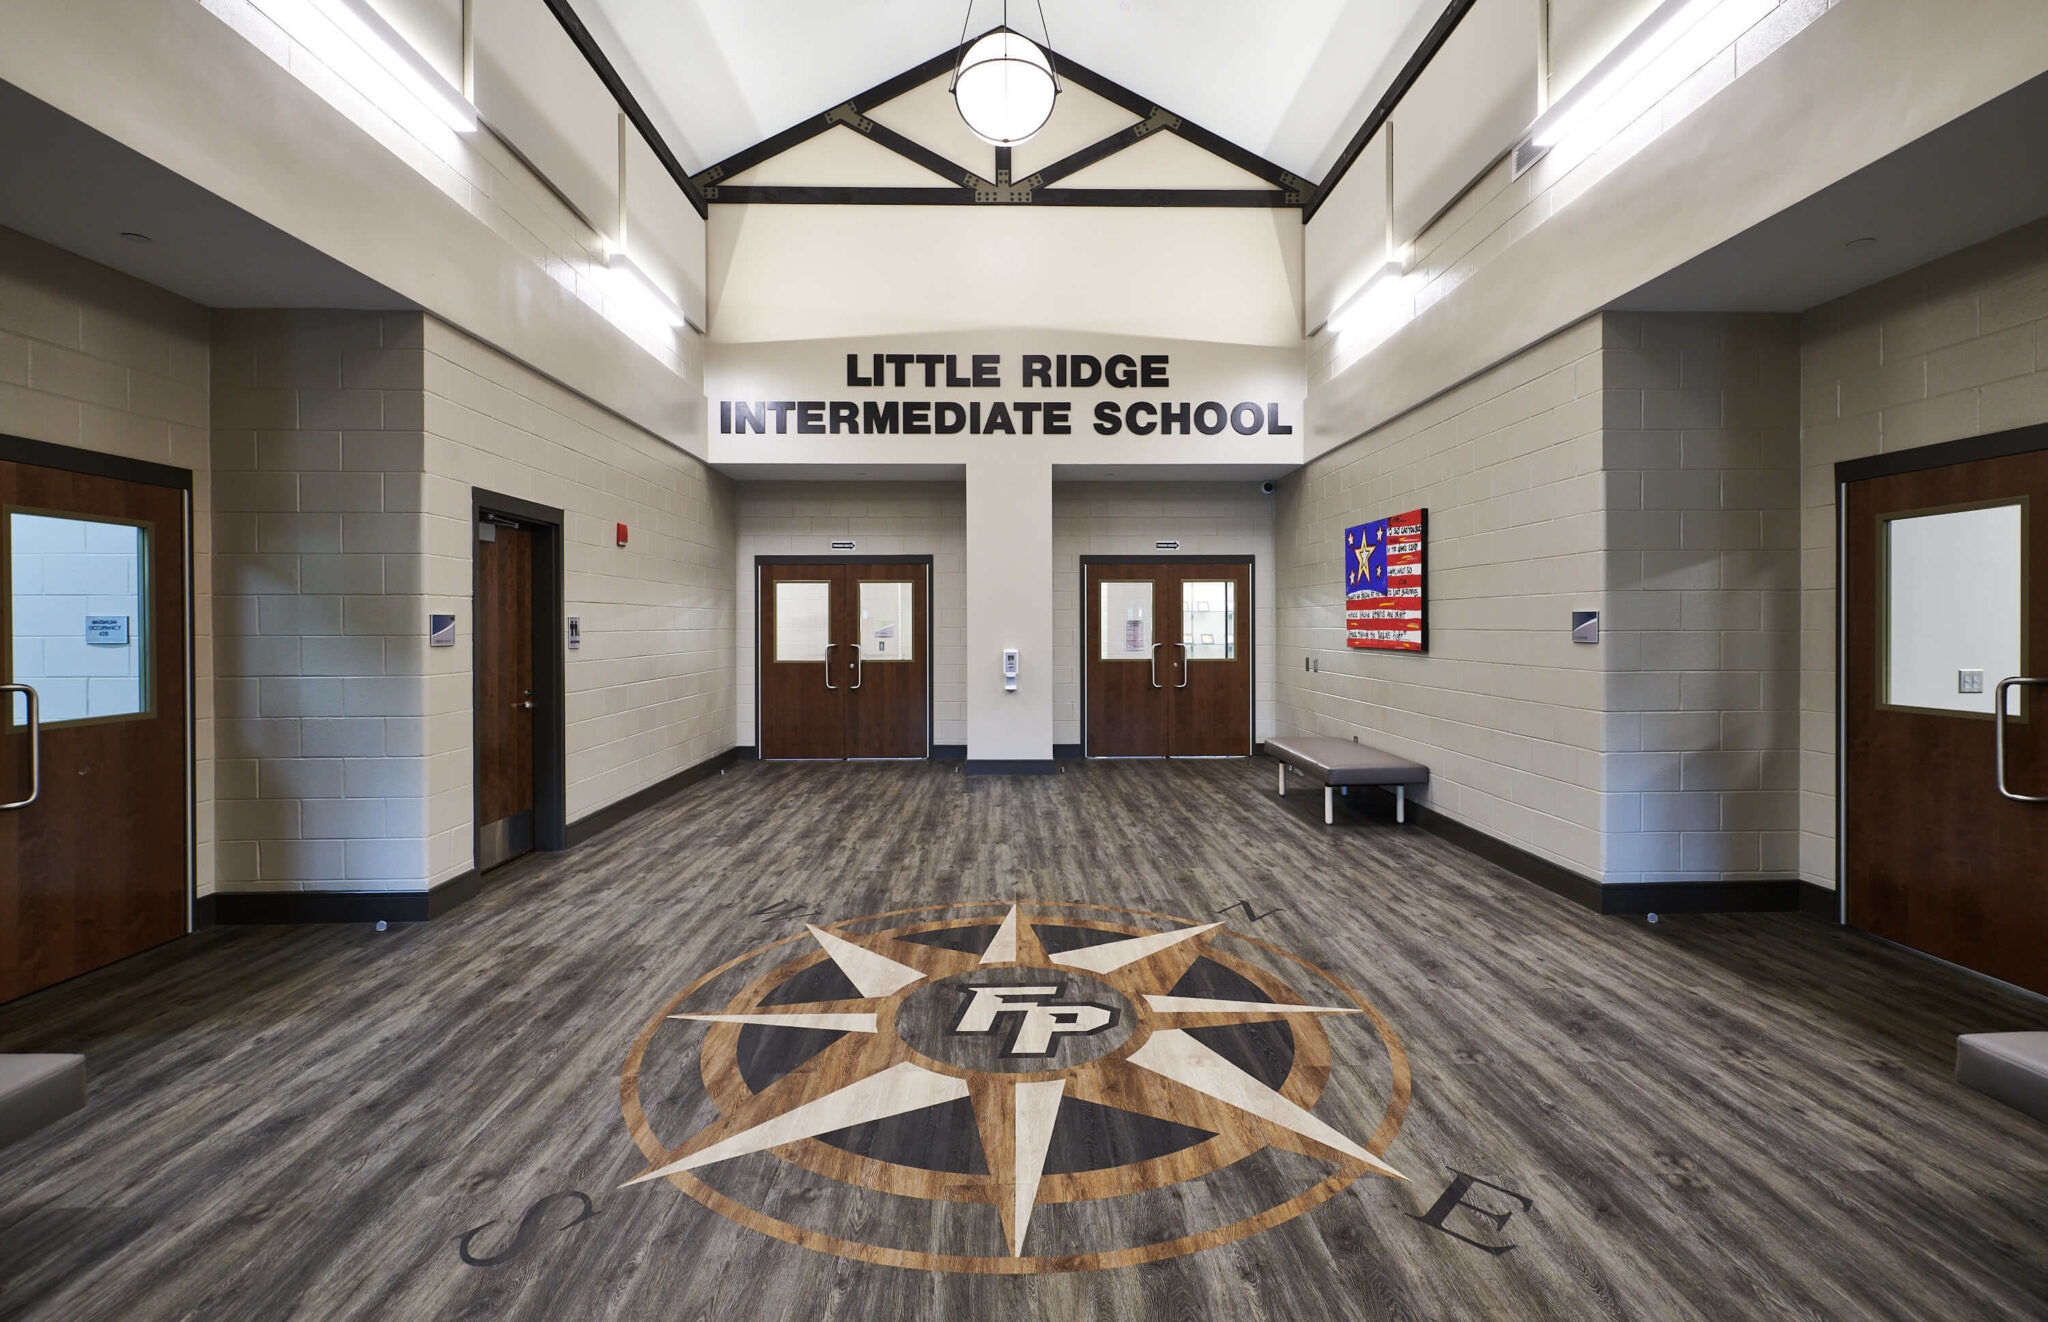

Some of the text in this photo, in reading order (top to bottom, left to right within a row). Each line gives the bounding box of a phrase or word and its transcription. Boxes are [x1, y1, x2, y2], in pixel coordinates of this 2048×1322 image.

[846, 353, 1170, 388] LITTLE RIDGE
[719, 400, 1293, 435] INTERMEDIATE SCHOOL
[953, 984, 1118, 1056] FP
[452, 1190, 601, 1267] S
[1404, 1166, 1534, 1256] E
